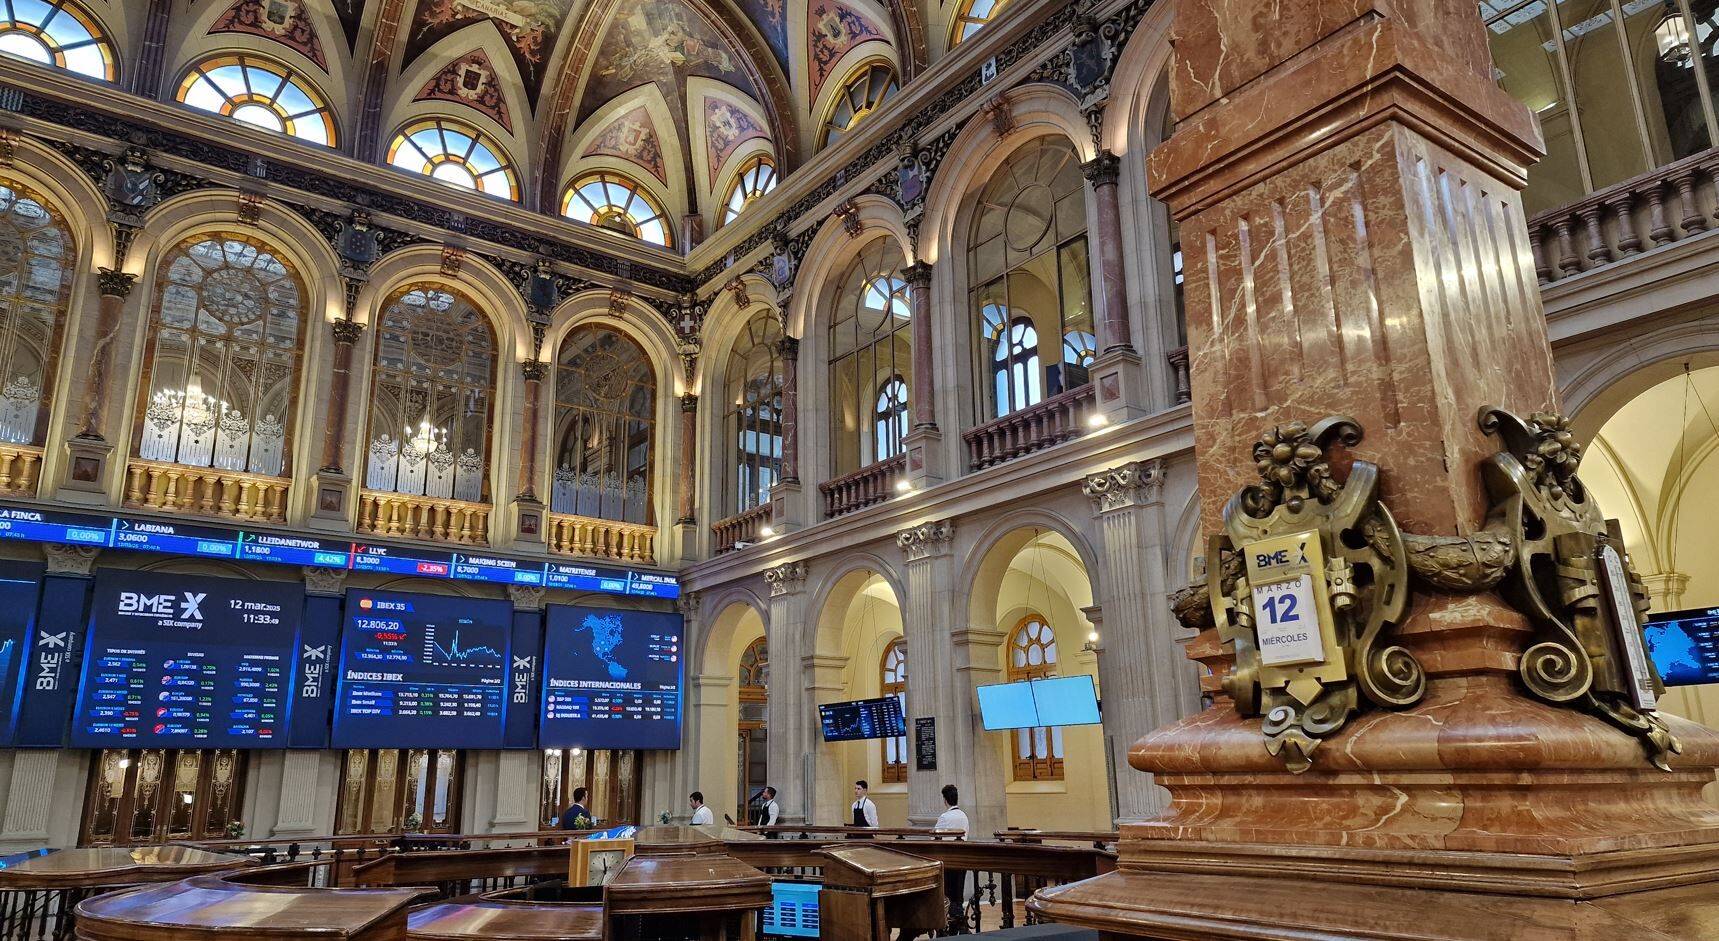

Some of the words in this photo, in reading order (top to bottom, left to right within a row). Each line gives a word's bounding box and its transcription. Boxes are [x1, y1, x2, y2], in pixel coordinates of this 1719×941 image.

[11, 510, 42, 520] FINCA
[134, 524, 174, 534] LABIANA
[118, 532, 148, 542] 3,0600
[258, 536, 320, 549] LLEIDANETWOR
[1256, 550, 1290, 568] BME
[1256, 580, 1302, 594] MARZO
[119, 592, 176, 613] BME
[230, 600, 242, 609] 12
[377, 602, 395, 610] IBEX
[1262, 594, 1300, 624] 12
[174, 621, 203, 630] company
[357, 620, 399, 630] 12.806,20
[36, 652, 58, 690] BME
[347, 670, 382, 680] ÍNDICES
[302, 663, 320, 698] BME
[550, 678, 578, 687] ÍNDICES
[579, 680, 641, 689] INTERNACIONALES
[514, 672, 527, 703] BME
